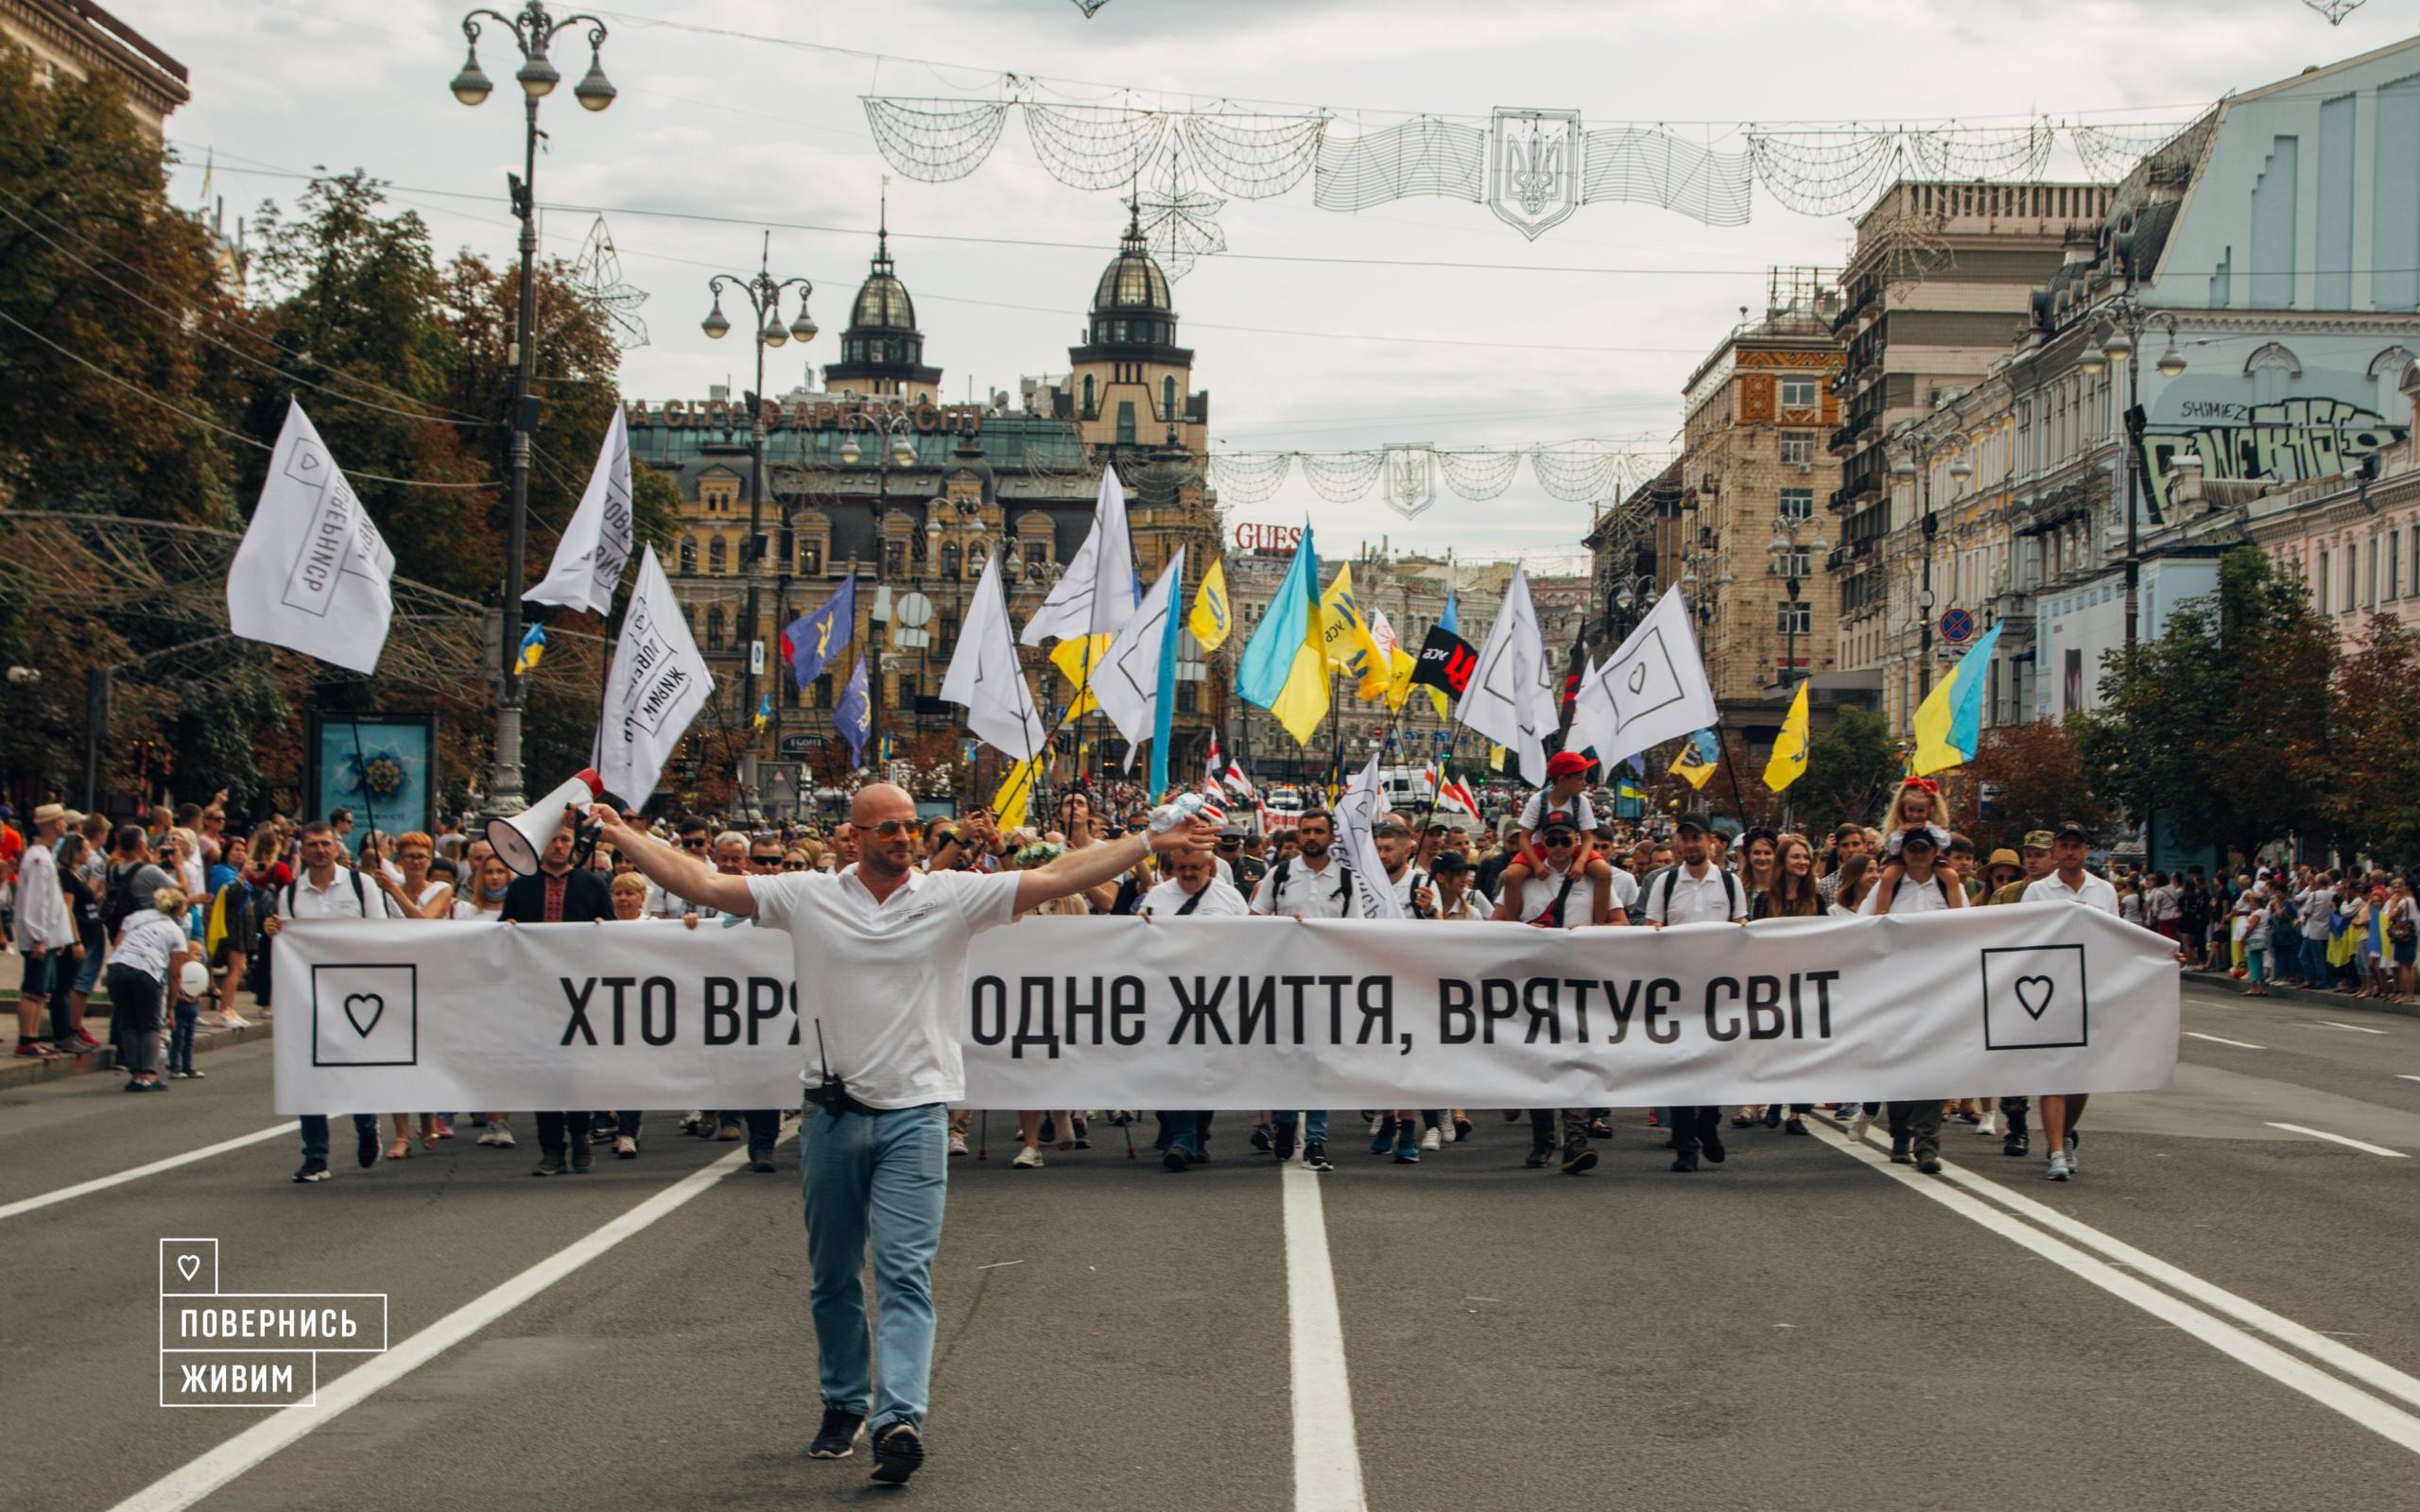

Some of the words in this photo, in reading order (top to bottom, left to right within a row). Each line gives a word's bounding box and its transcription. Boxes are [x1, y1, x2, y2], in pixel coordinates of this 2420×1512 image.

[662, 399, 744, 427] CITY
[560, 976, 677, 1046] ХТО
[1167, 975, 1412, 1056] ЖИТТЯ,
[1439, 977, 1682, 1044] ВРЯТУЄ
[1705, 971, 1841, 1041] СВІТ
